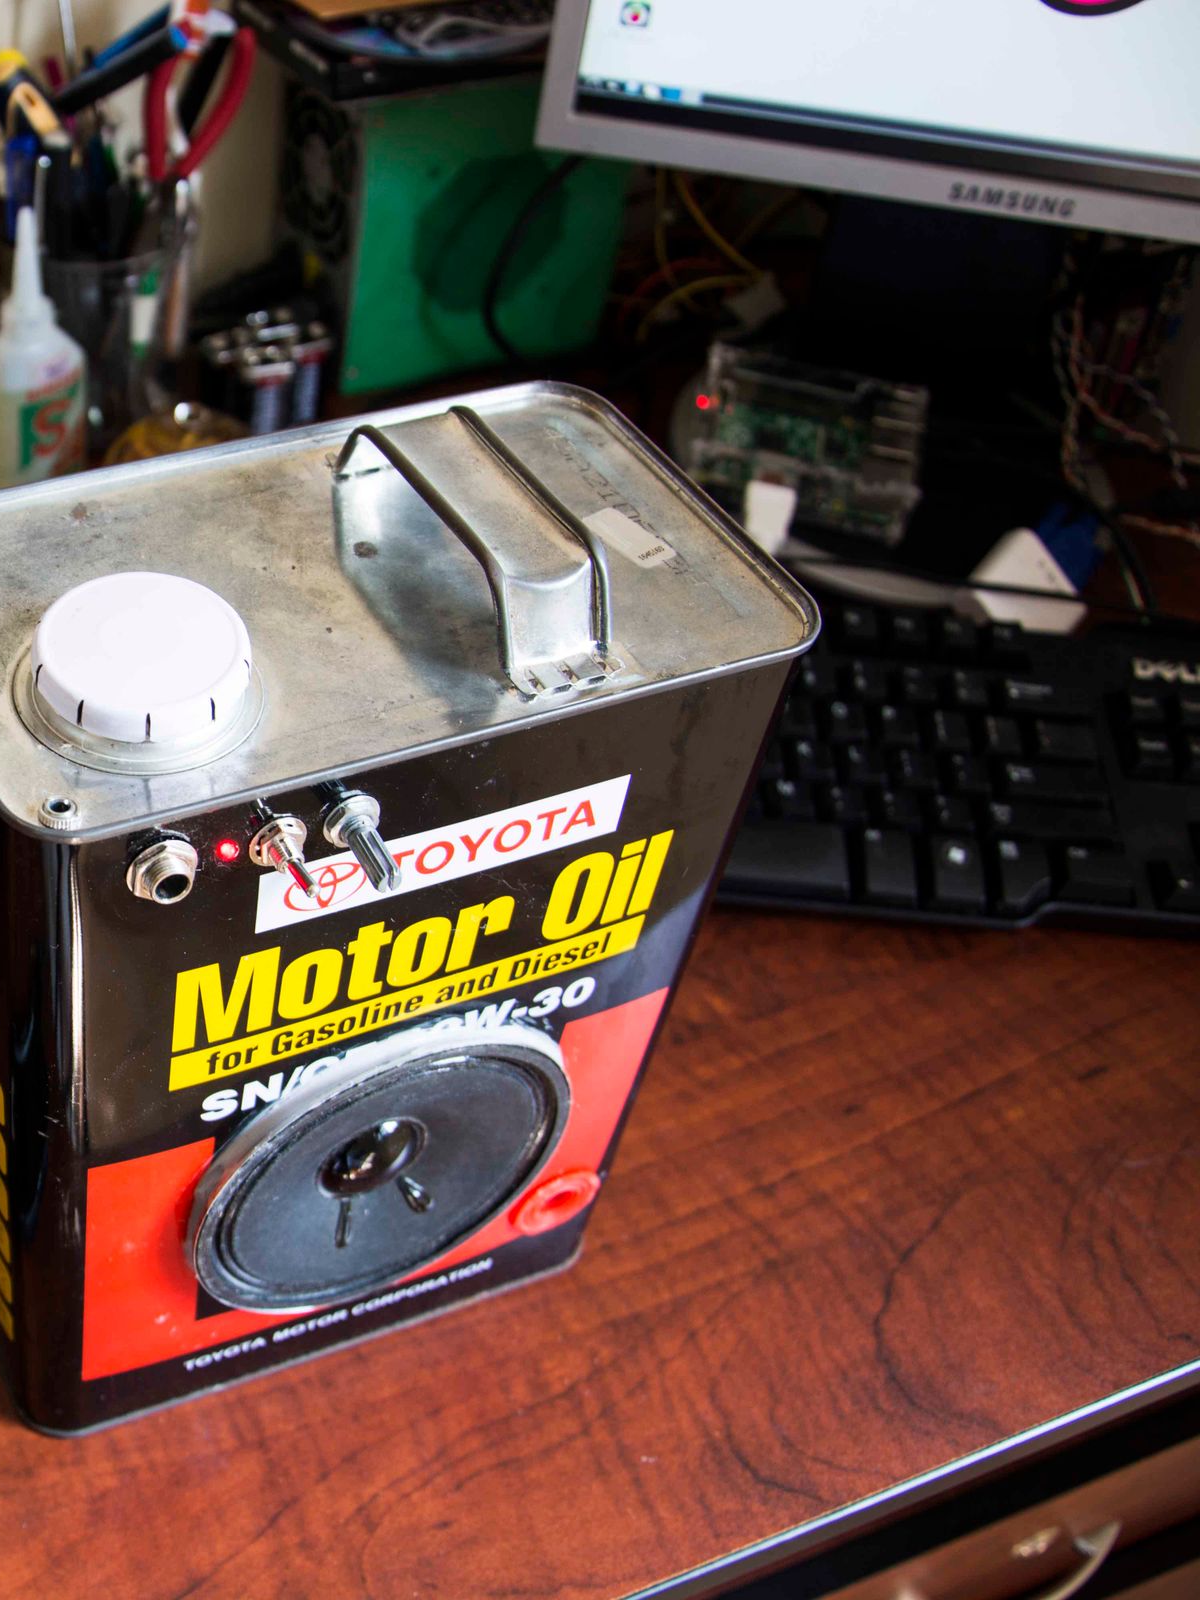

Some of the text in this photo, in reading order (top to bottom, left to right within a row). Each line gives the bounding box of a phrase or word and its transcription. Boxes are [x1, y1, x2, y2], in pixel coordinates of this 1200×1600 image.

[948, 182, 1076, 218] SAMSUNG
[392, 800, 596, 876] TOYOTA
[172, 829, 675, 1053] Motor Oil
[206, 931, 612, 1076] for Gasoline and Diesel
[184, 1256, 494, 1373] TOYOTA MOTOR CORPORATION
